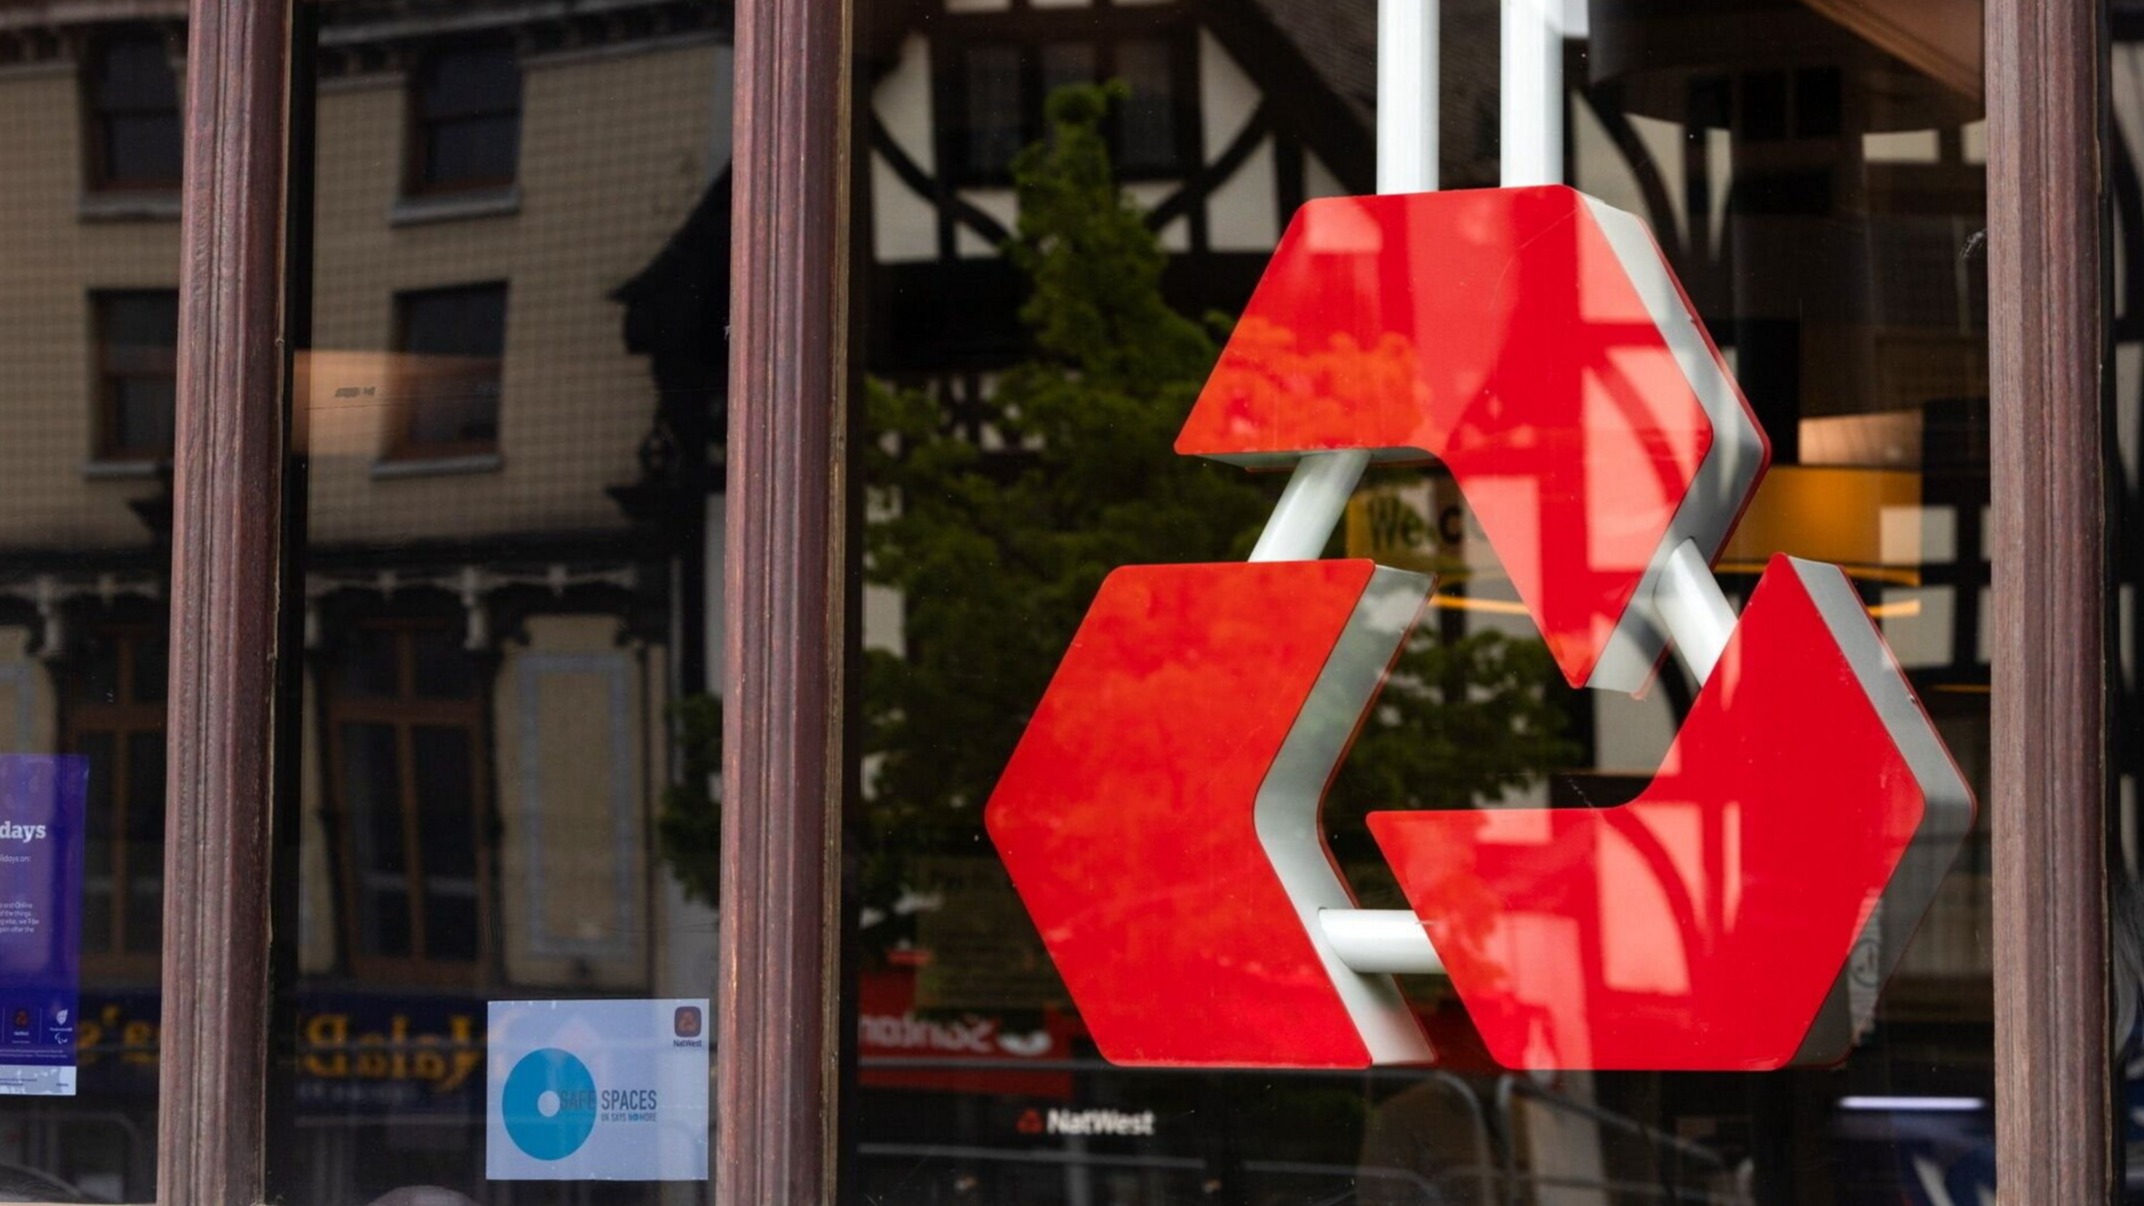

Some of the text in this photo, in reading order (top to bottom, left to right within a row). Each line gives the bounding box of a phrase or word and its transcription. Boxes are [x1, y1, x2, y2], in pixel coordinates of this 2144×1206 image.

[673, 1039, 702, 1047] NatWest
[559, 1089, 657, 1110] SAFE SPACES
[1047, 1109, 1155, 1135] NatWest
